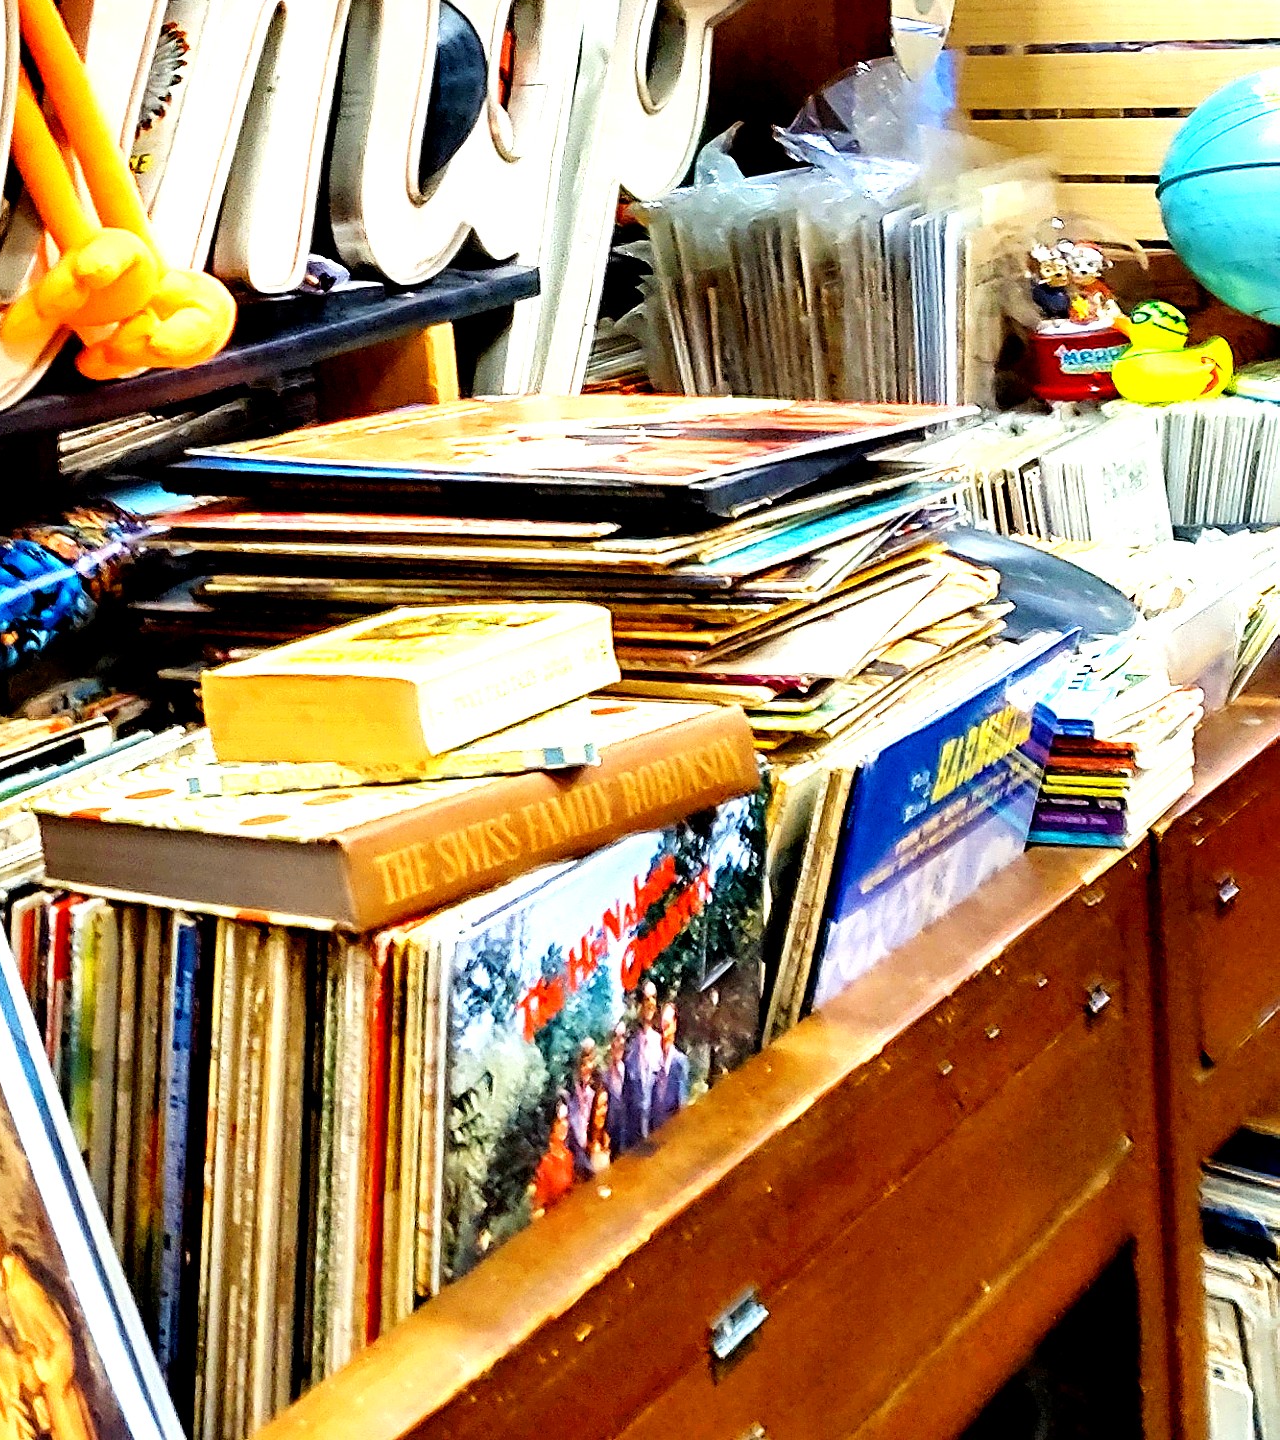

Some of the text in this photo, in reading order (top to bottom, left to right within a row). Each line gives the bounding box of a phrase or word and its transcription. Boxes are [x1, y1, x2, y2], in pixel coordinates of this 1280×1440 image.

[374, 737, 742, 905] THE SWISS FAMILY ROBINSON
